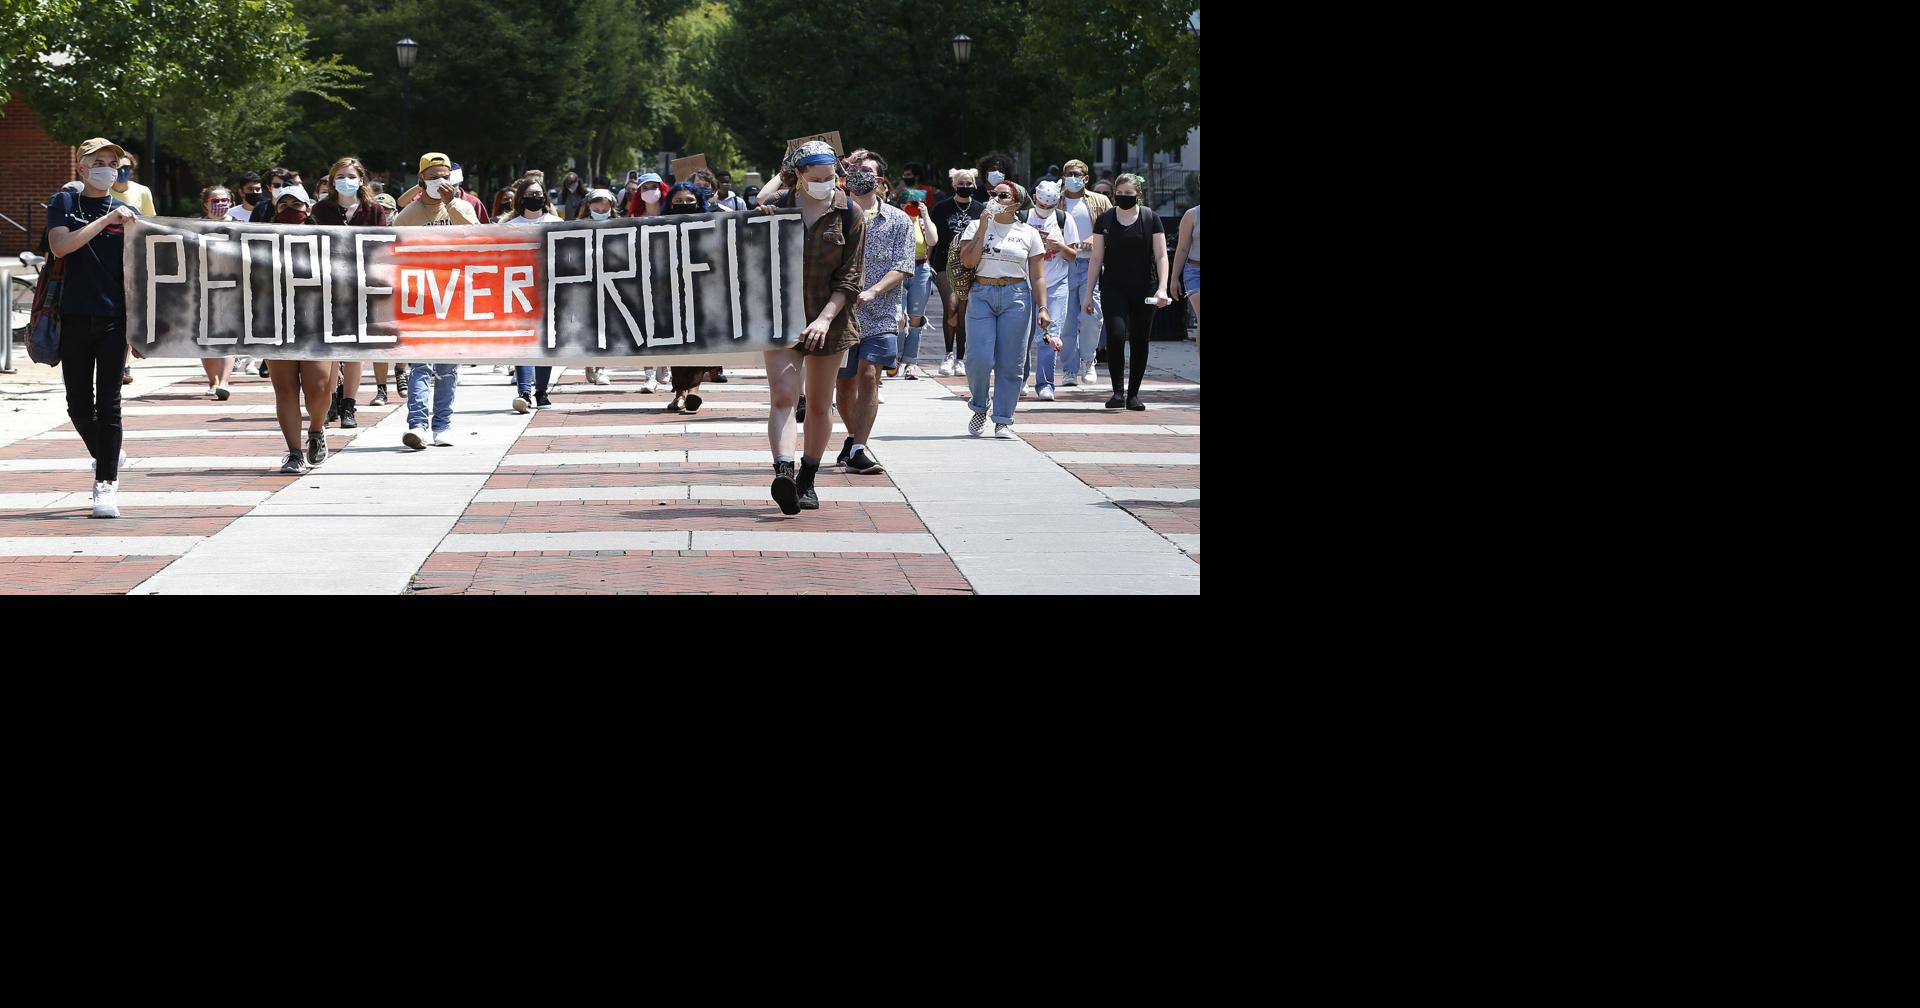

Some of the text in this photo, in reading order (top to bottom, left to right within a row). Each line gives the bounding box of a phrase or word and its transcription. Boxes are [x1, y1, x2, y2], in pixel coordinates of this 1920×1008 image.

[146, 214, 802, 349] PEOPLE OVER PROFIT
